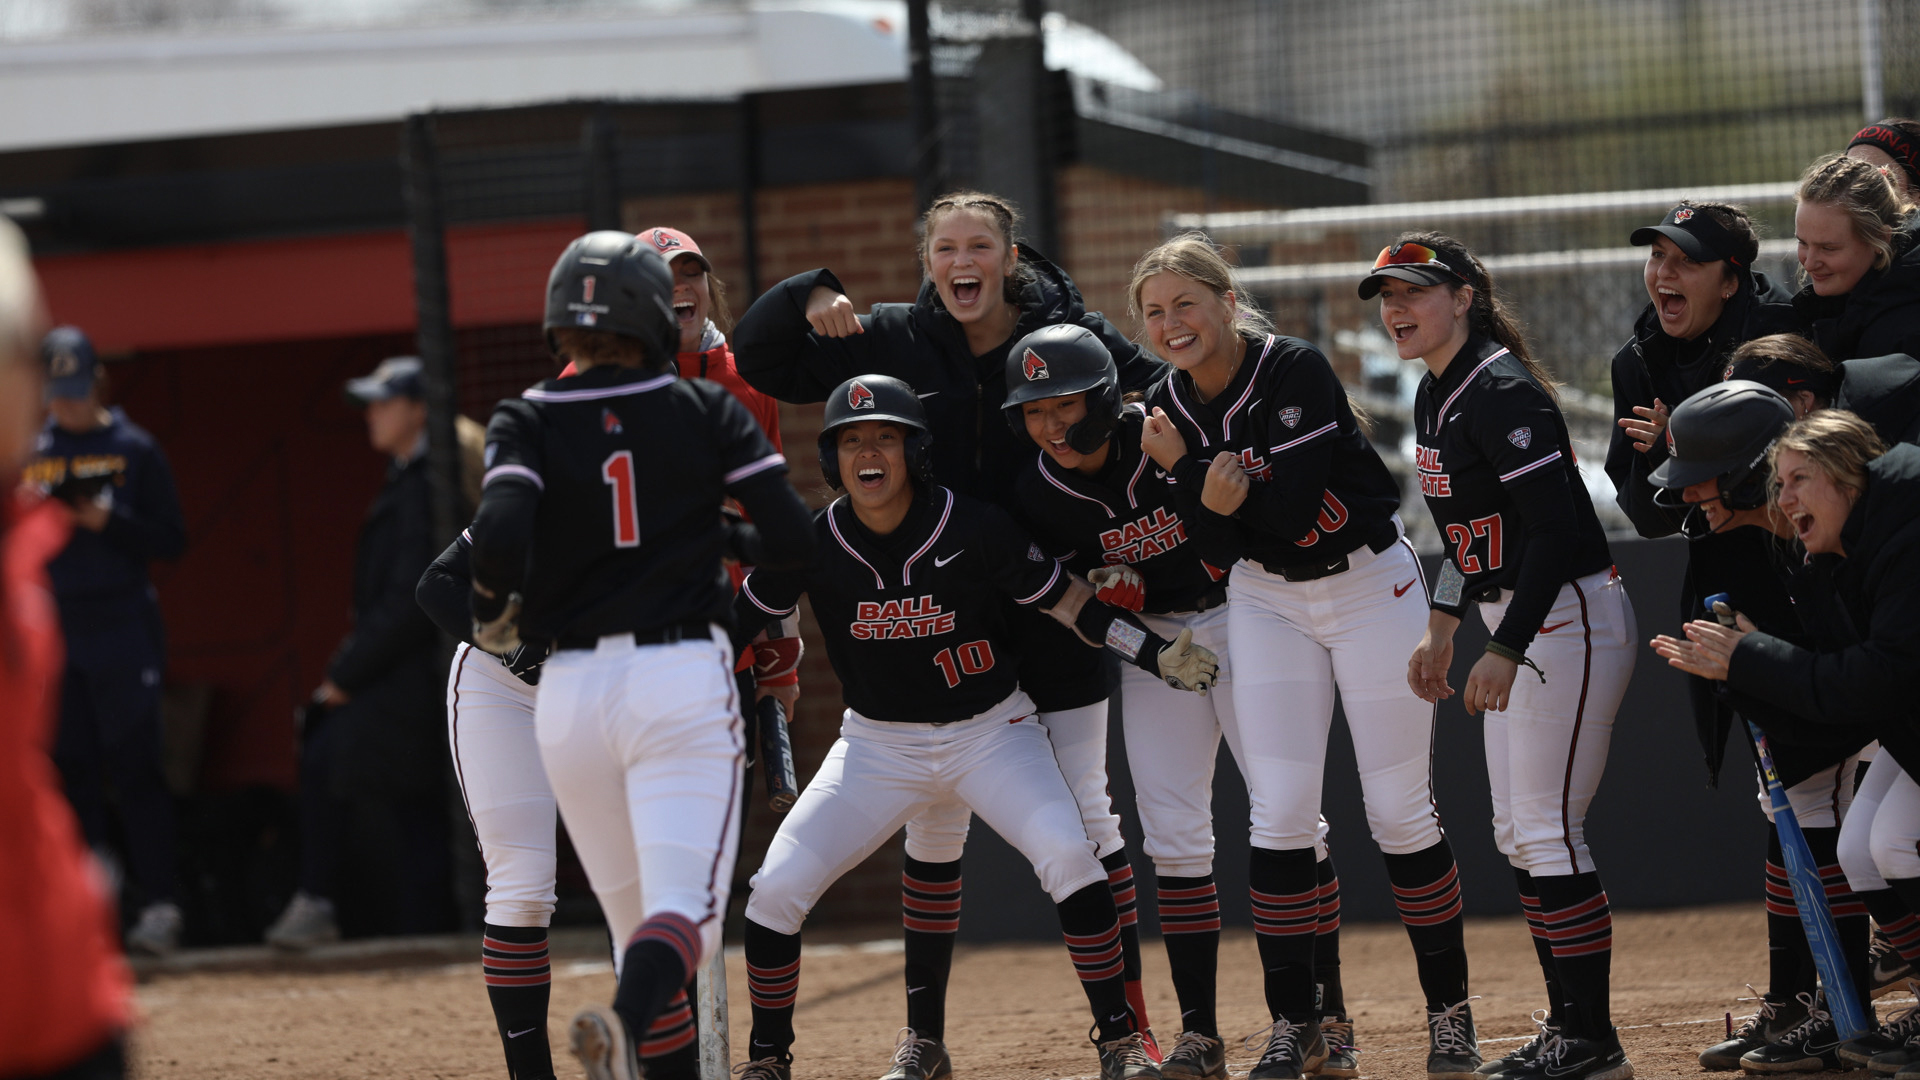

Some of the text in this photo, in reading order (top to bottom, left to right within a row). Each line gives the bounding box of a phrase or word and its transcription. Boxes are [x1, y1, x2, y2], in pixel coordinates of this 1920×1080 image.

[583, 275, 596, 304] 1
[602, 449, 640, 548] 1
[1418, 473, 1452, 497] ATE
[1099, 505, 1178, 551] BALL
[1445, 512, 1502, 574] 27
[850, 610, 955, 640] STATE
[857, 594, 941, 621] BALL
[933, 639, 995, 689] 10
